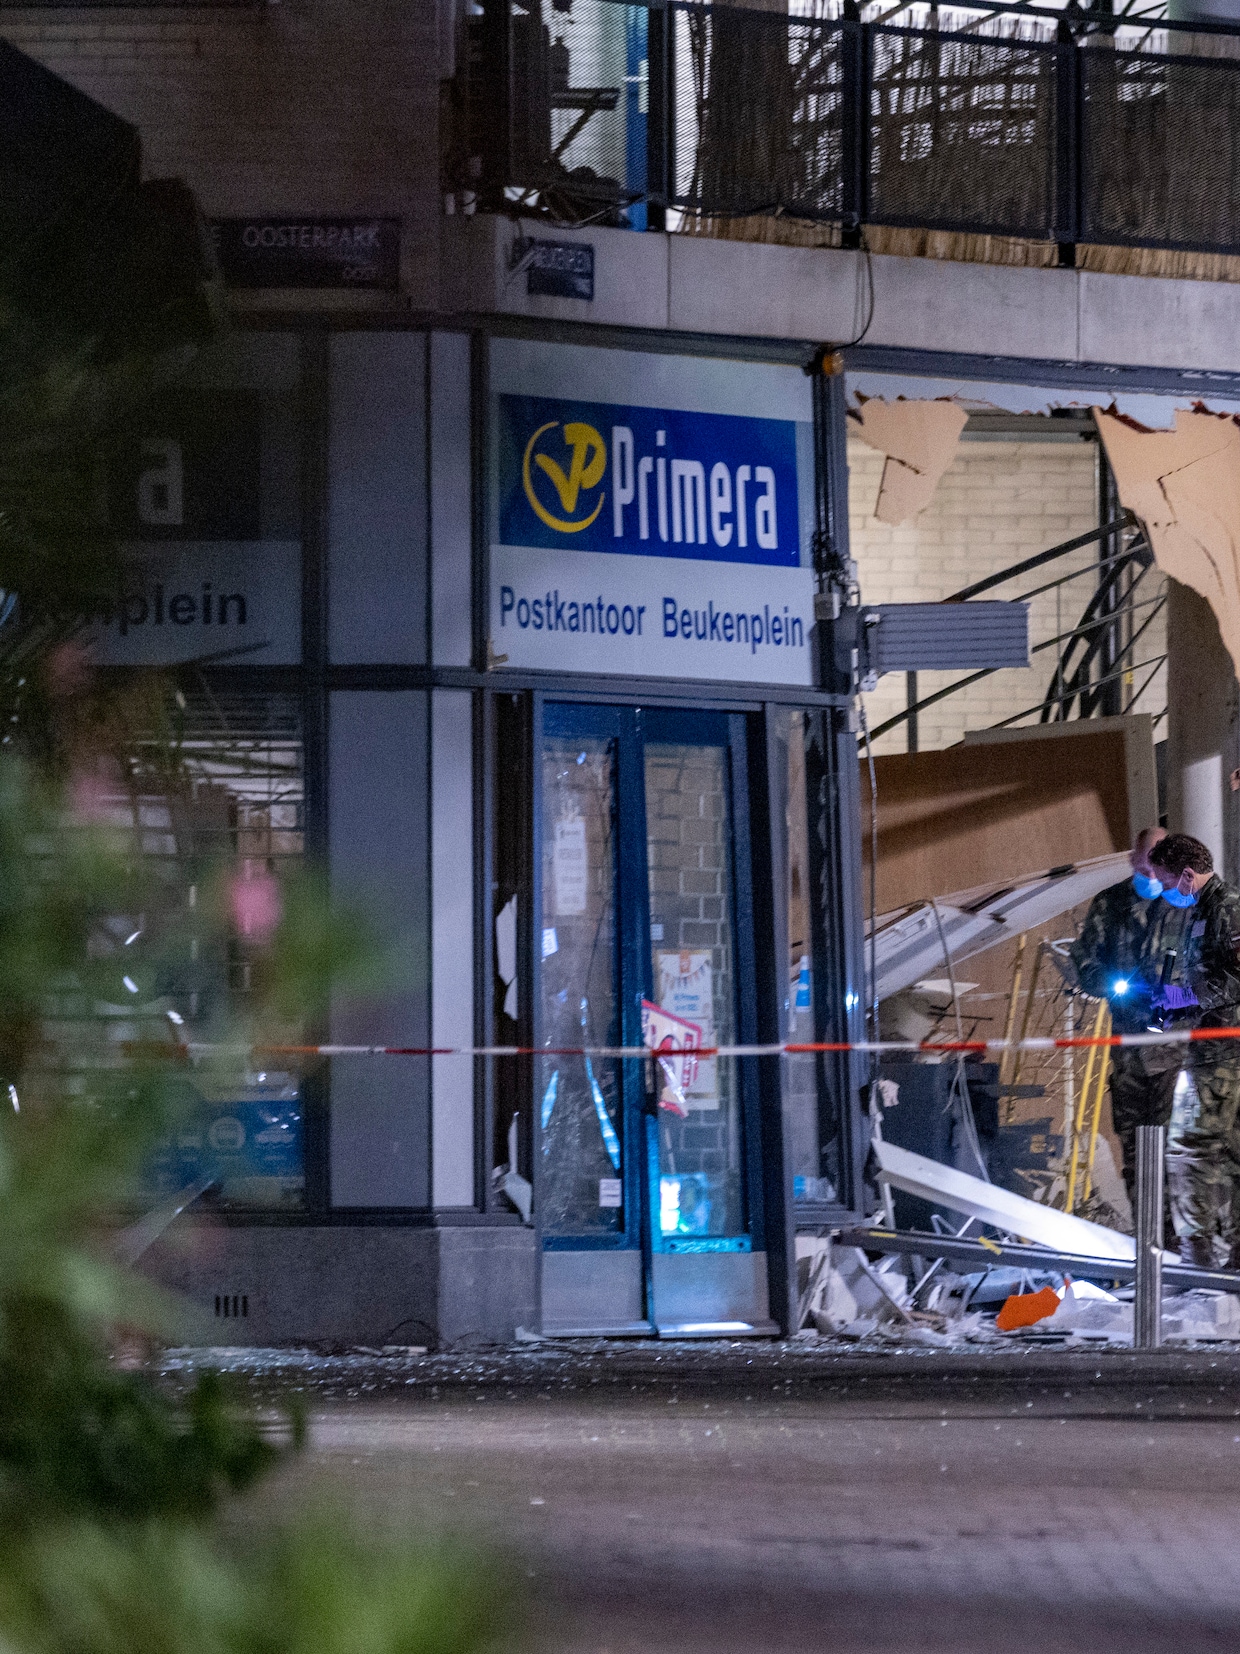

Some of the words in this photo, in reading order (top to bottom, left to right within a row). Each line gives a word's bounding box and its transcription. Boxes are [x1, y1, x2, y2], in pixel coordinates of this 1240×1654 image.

[612, 425, 778, 550] Primera
[500, 586, 647, 636] Postkantoor
[662, 596, 804, 655] Beukenplein
